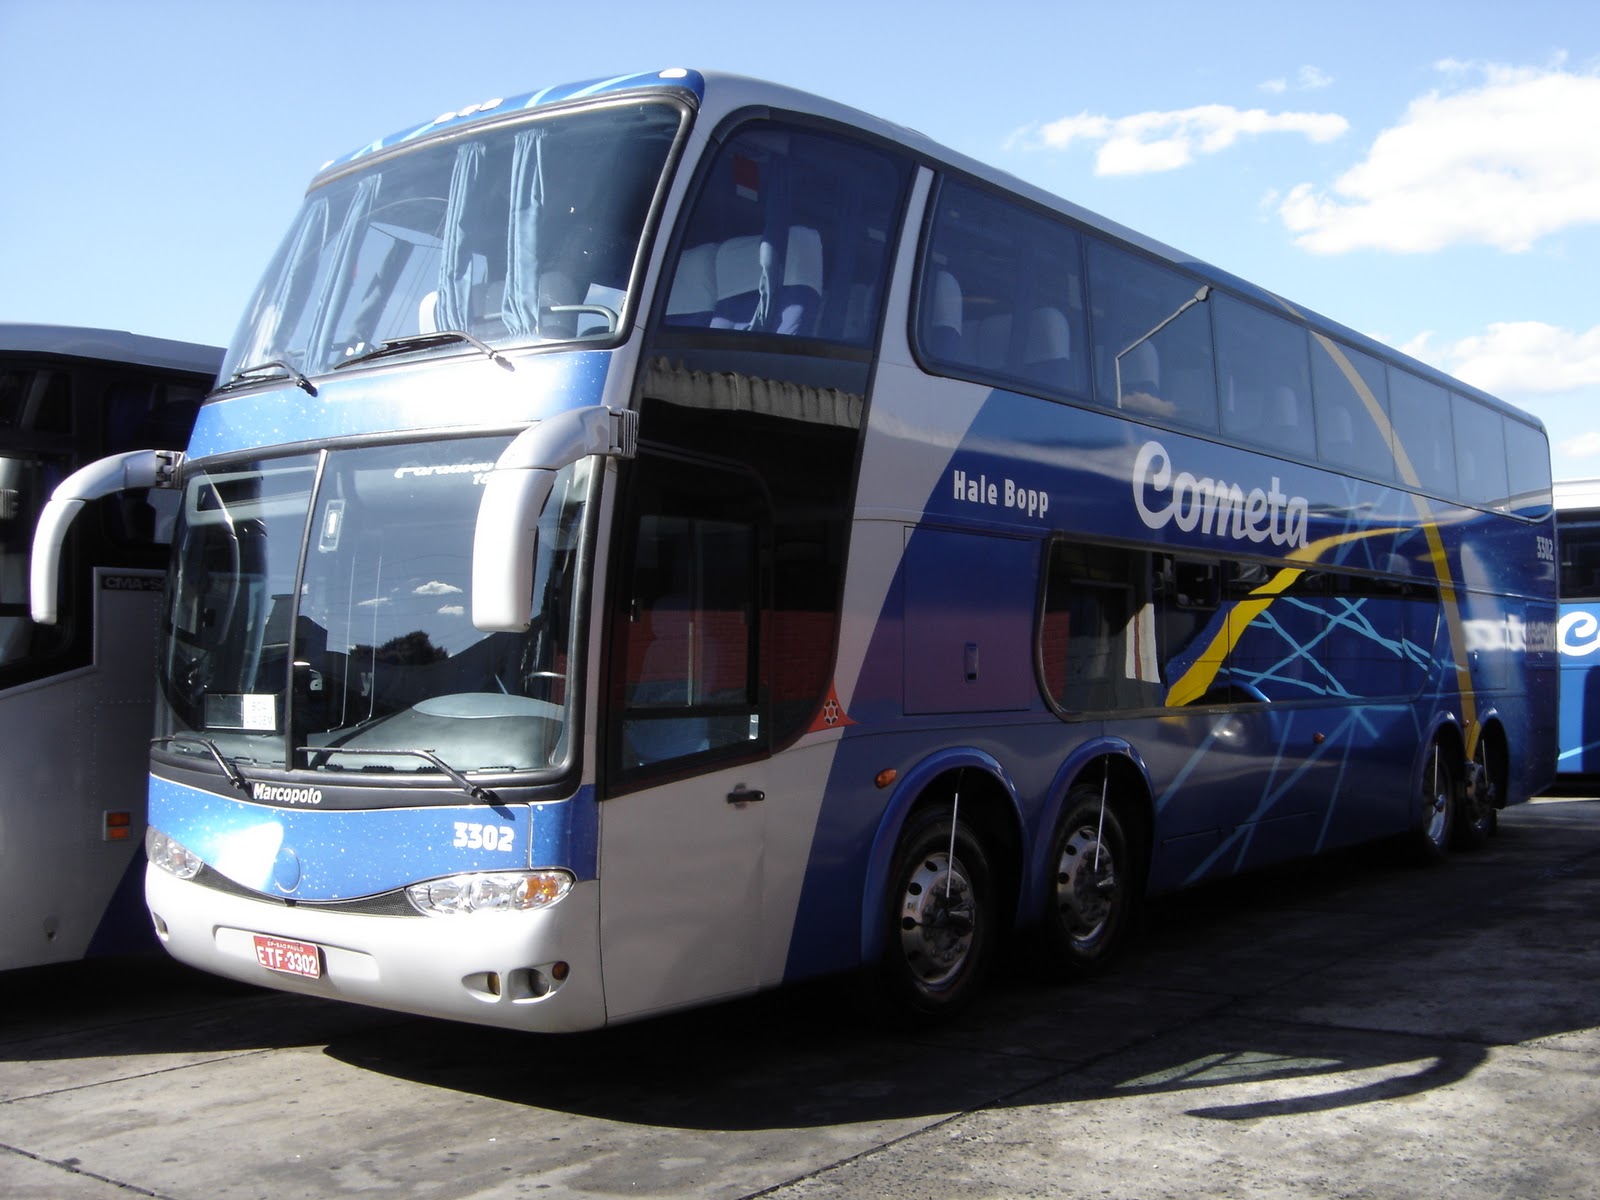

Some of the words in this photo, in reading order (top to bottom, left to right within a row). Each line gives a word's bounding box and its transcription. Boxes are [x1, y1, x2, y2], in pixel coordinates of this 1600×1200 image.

[953, 469, 998, 506] Hale
[1004, 478, 1049, 519] Bopp
[1133, 441, 1309, 549] Cometa
[253, 782, 322, 804] Marcopolo
[453, 821, 515, 852] 3302
